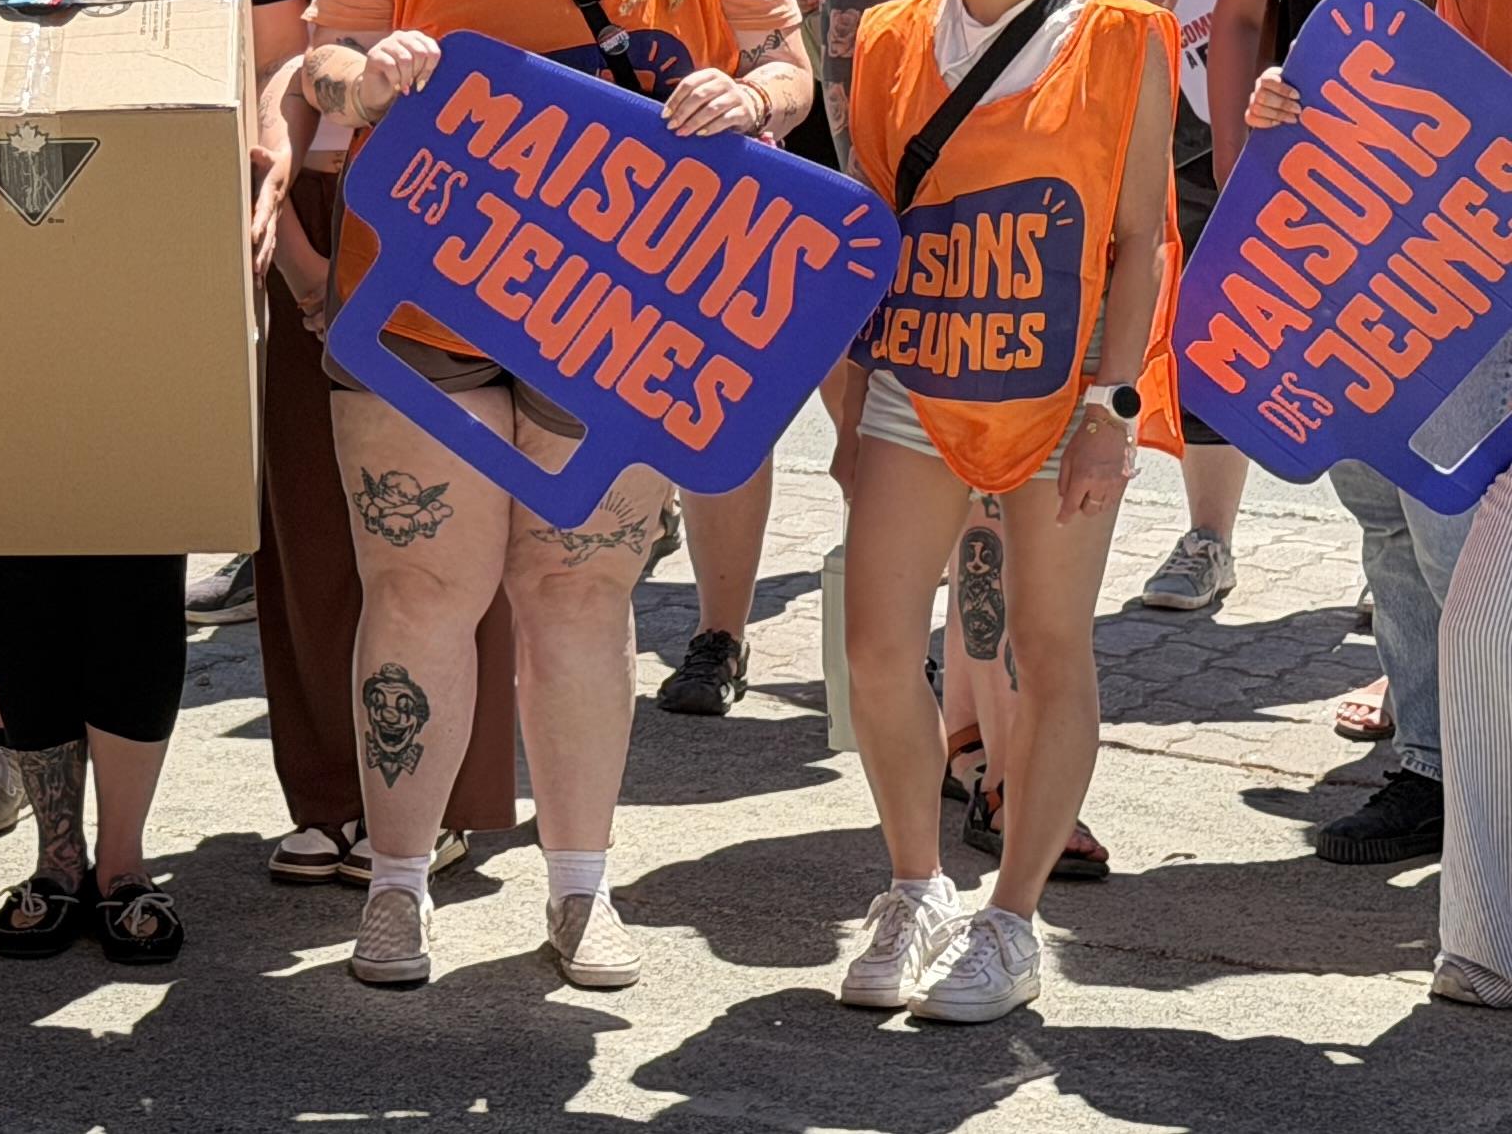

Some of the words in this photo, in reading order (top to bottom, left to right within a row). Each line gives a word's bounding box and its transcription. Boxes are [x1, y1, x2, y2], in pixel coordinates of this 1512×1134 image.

[391, 148, 469, 226] DES
[435, 70, 841, 350] MAISONS
[892, 212, 1049, 300] ISONS
[1185, 40, 1472, 394] MAISONS
[433, 192, 753, 451] JEUNES
[1257, 372, 1335, 444] DES
